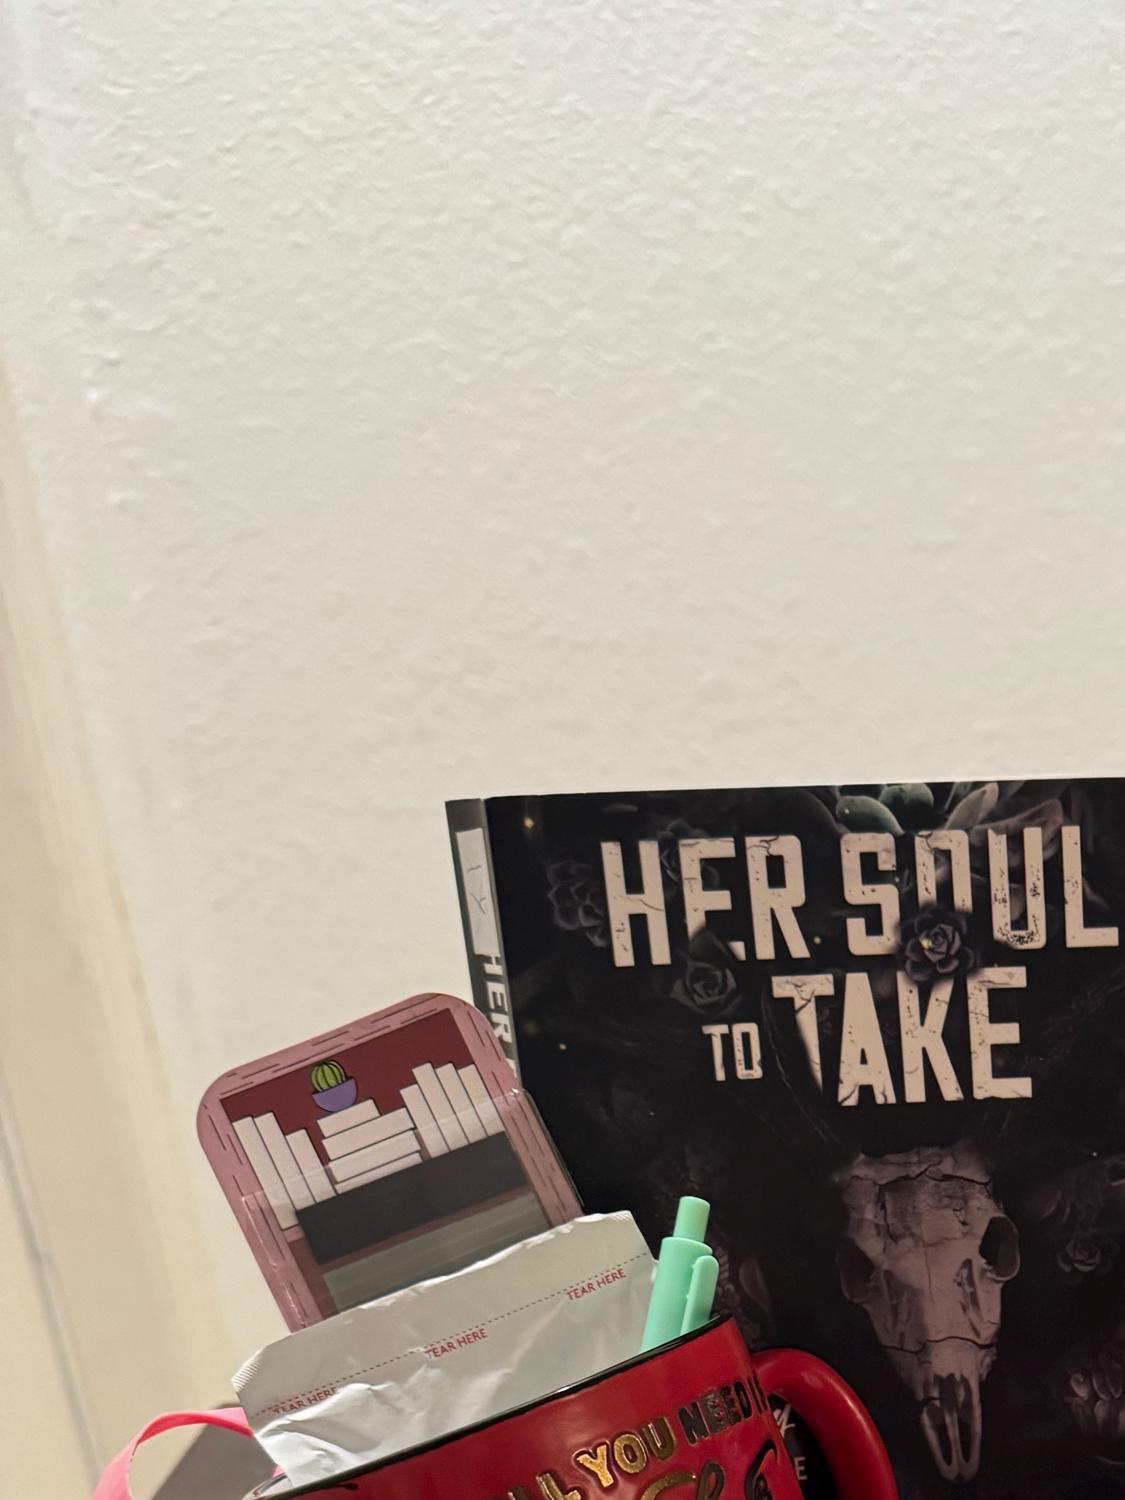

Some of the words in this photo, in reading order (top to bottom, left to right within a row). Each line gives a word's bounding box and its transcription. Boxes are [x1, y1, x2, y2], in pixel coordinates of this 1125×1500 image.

[601, 836, 811, 967] HER
[840, 825, 1119, 958] SOUL
[702, 1022, 763, 1082] TO
[771, 966, 1033, 1107] TAKE
[565, 1276, 596, 1302] TEAR
[596, 1267, 627, 1292] HERE
[425, 1336, 457, 1361] TEAR
[456, 1327, 488, 1352] HERE
[576, 1416, 676, 1488] YOU
[677, 1379, 752, 1445] NEED
